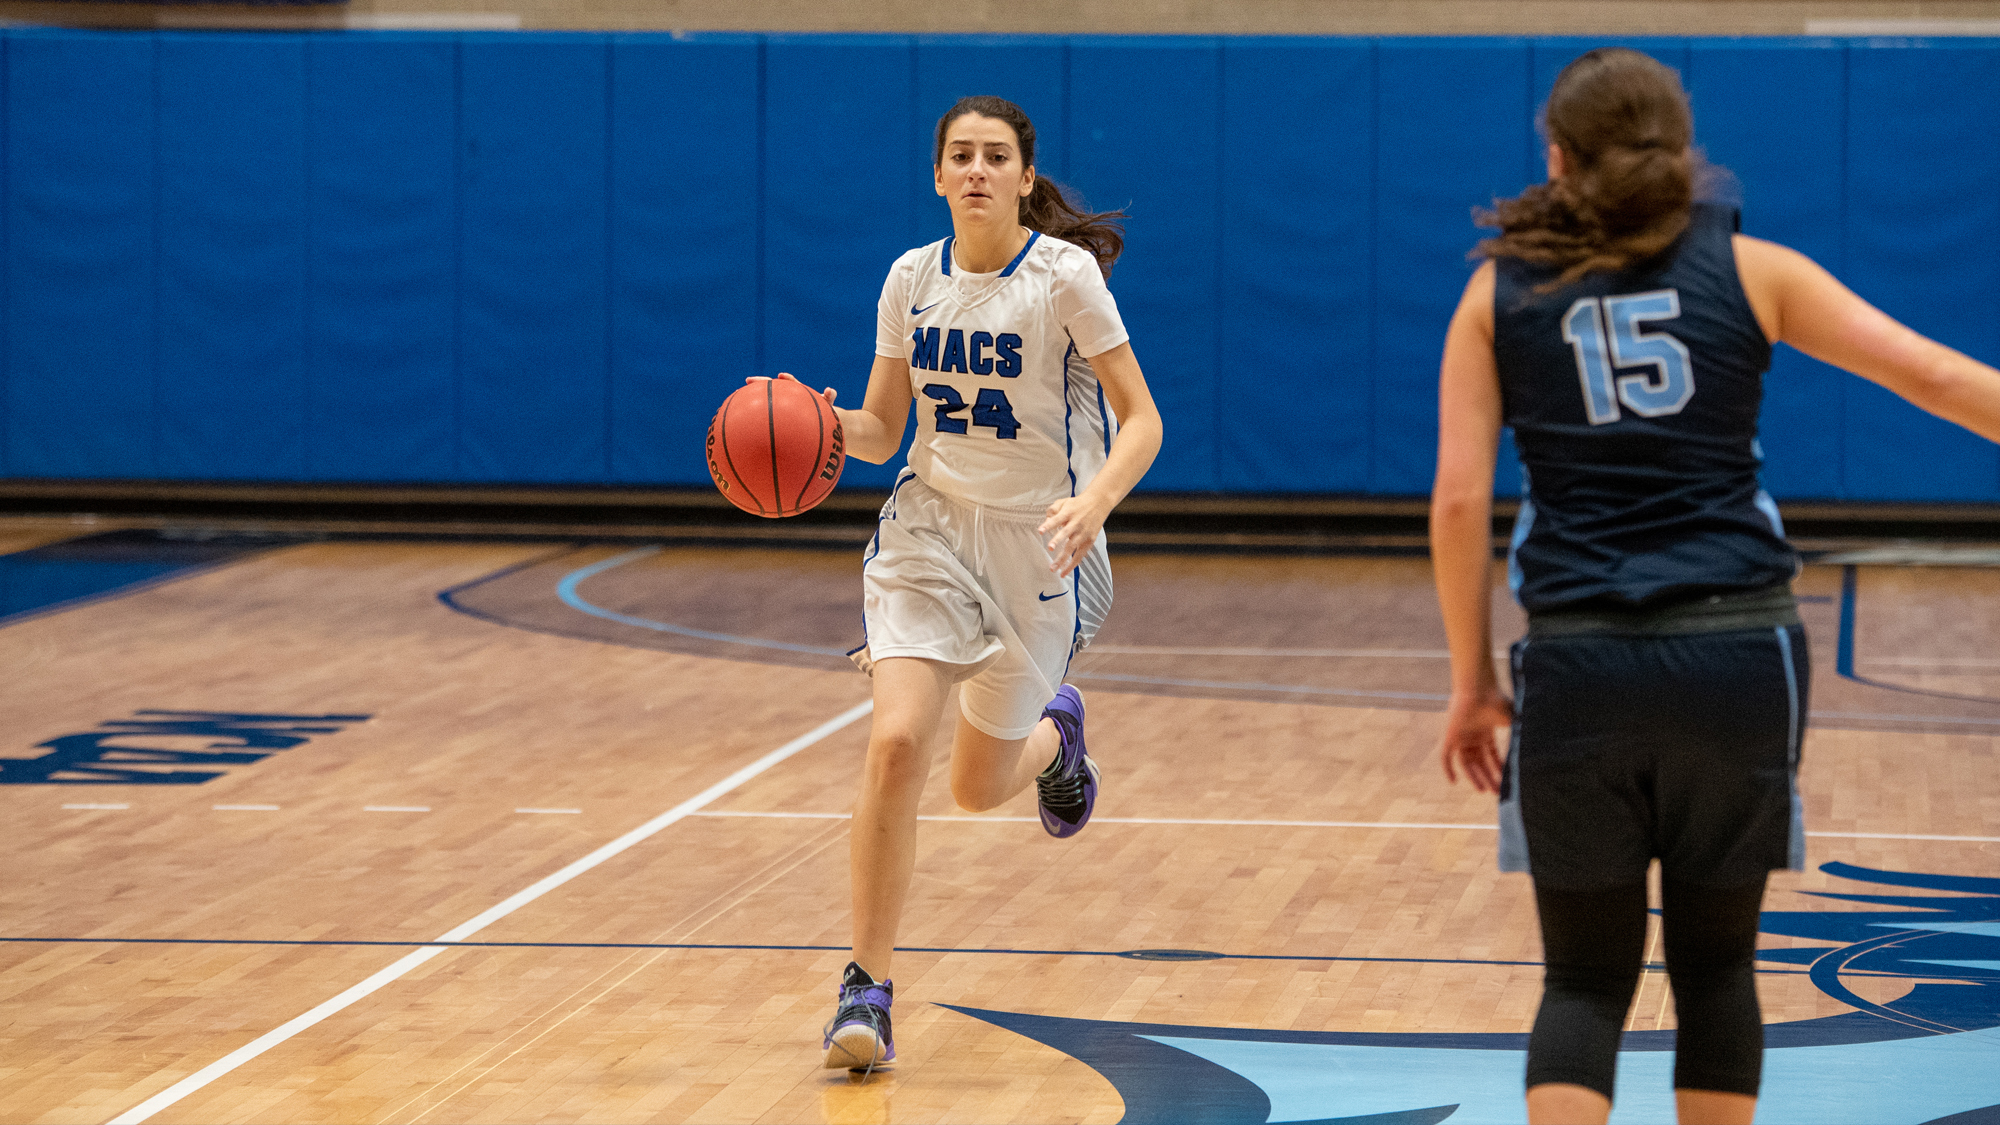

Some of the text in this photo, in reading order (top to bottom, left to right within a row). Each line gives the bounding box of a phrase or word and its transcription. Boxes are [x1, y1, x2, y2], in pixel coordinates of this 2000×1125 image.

[911, 326, 1022, 378] MACS
[1560, 288, 1696, 426] 15
[921, 383, 1022, 440] 24
